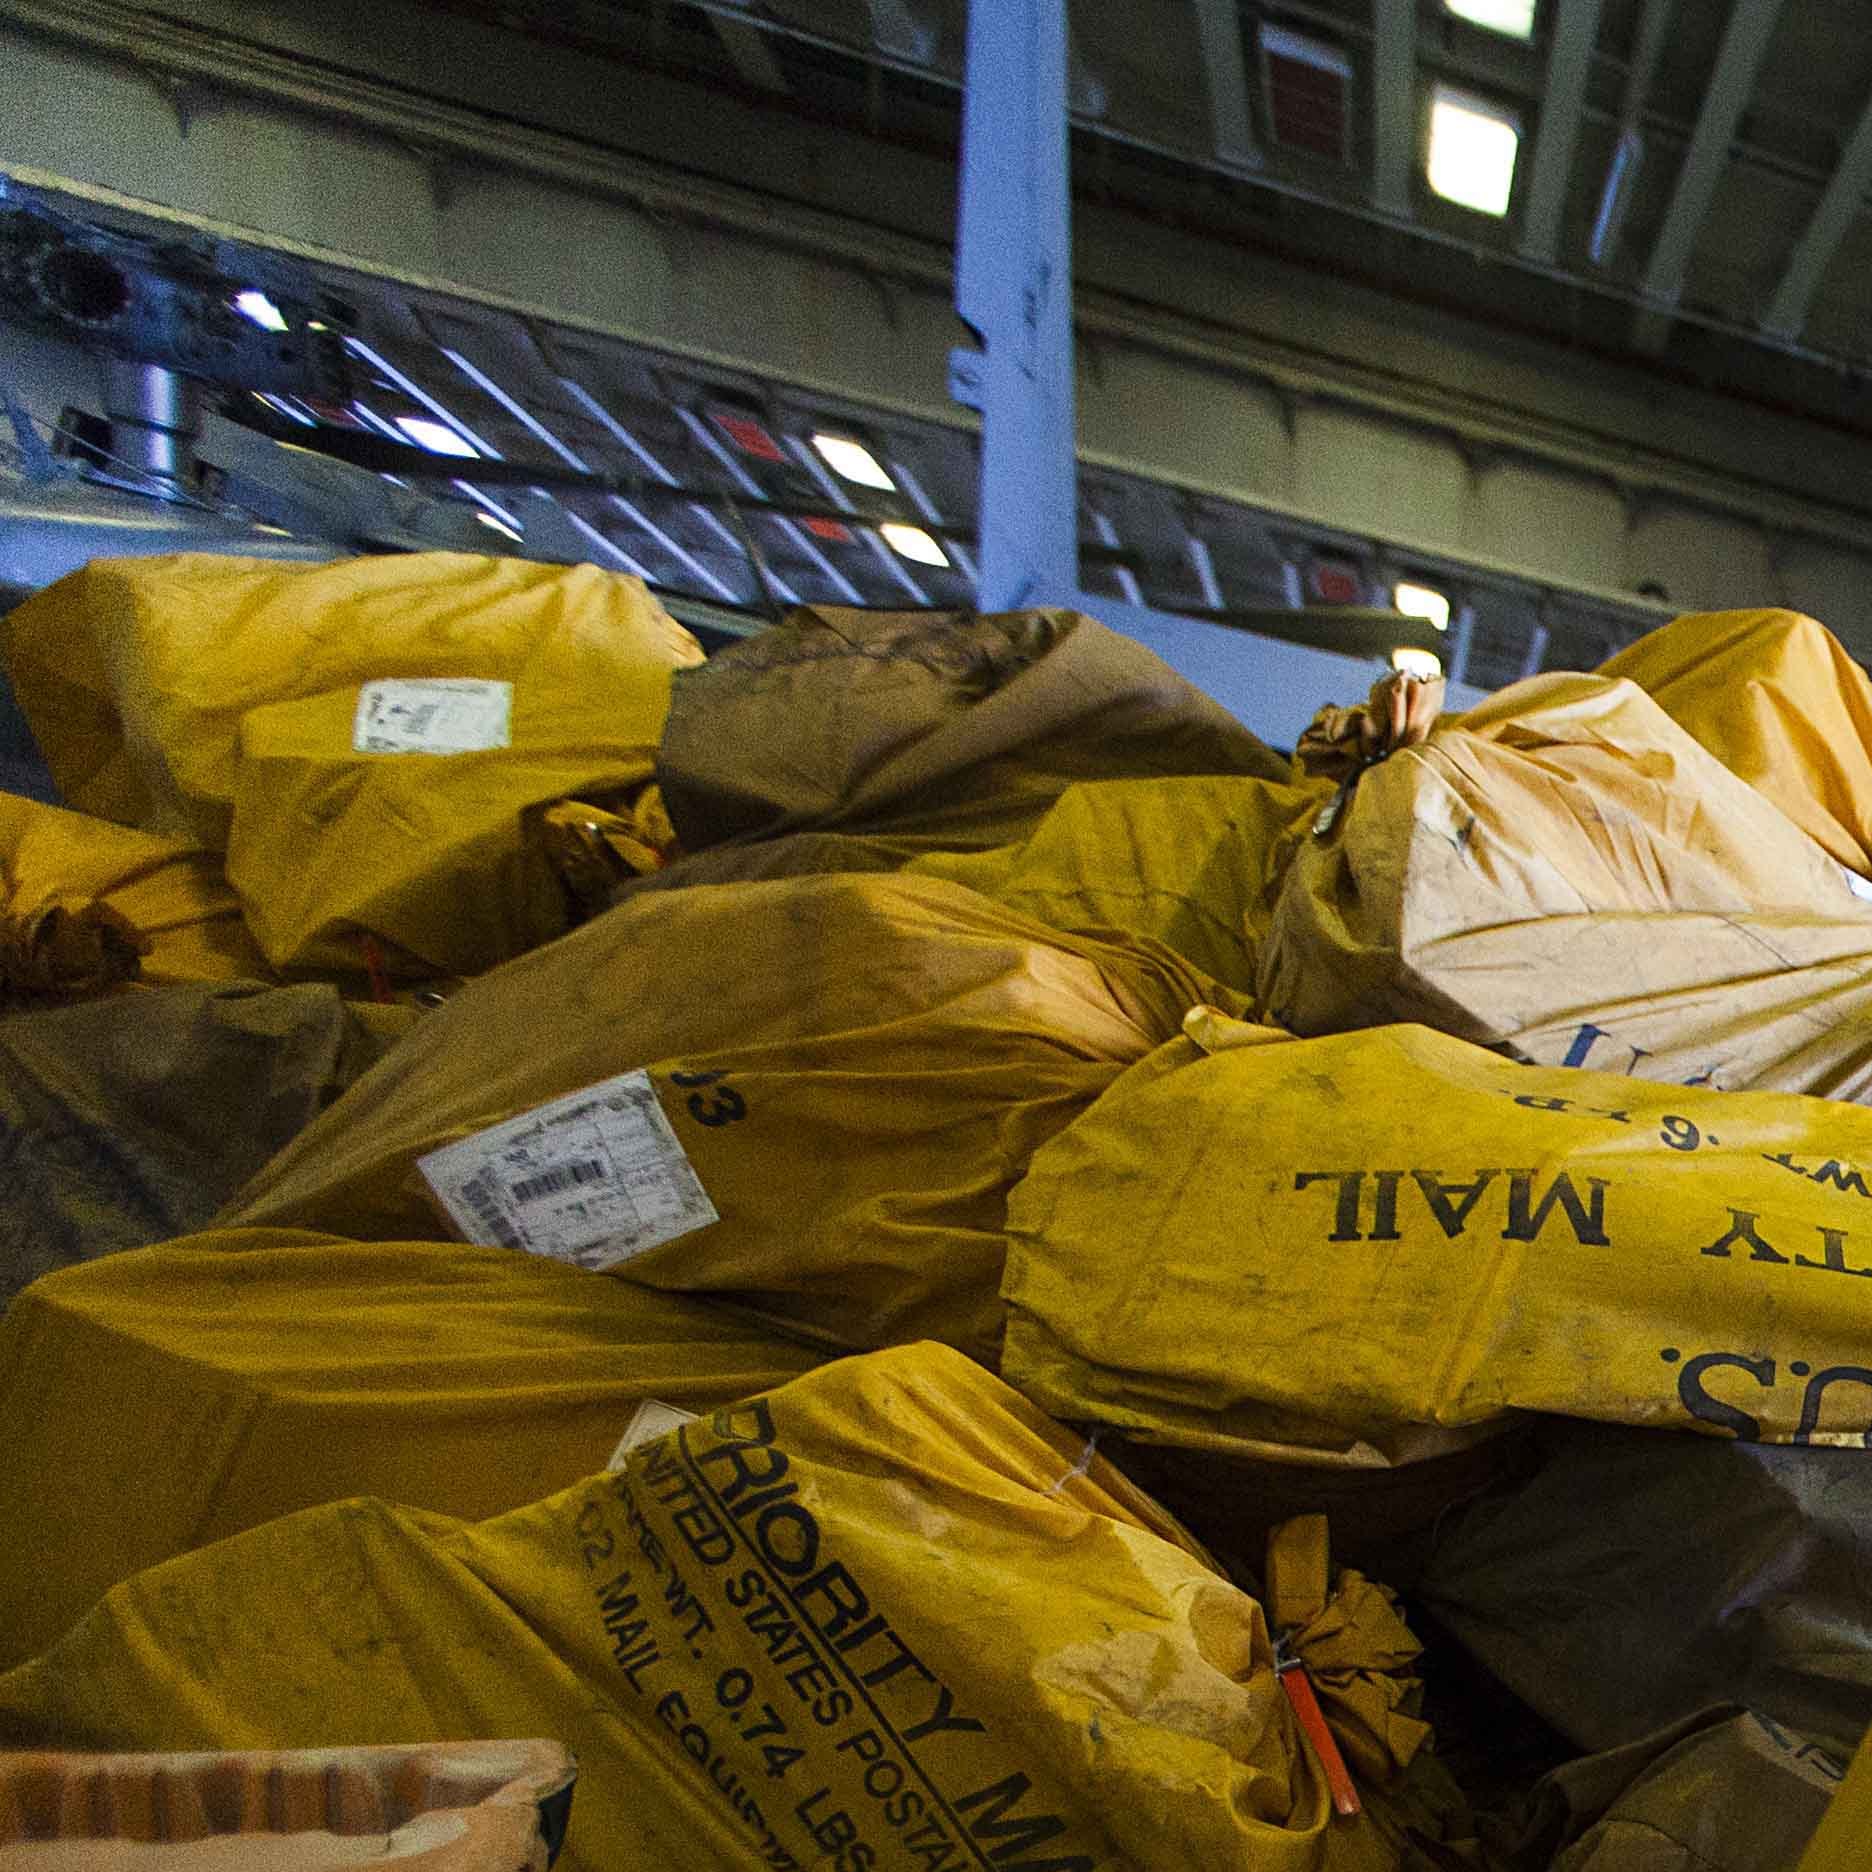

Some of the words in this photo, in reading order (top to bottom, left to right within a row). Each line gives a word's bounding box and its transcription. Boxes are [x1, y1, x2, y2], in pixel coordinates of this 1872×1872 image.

[1294, 1167, 1612, 1247] MAIL
[595, 1570, 661, 1696] MAIL
[638, 1440, 738, 1567] NITED
[724, 1568, 855, 1728] STATES
[699, 1398, 988, 1743] PRIORITY
[714, 1667, 808, 1780] 0.74
